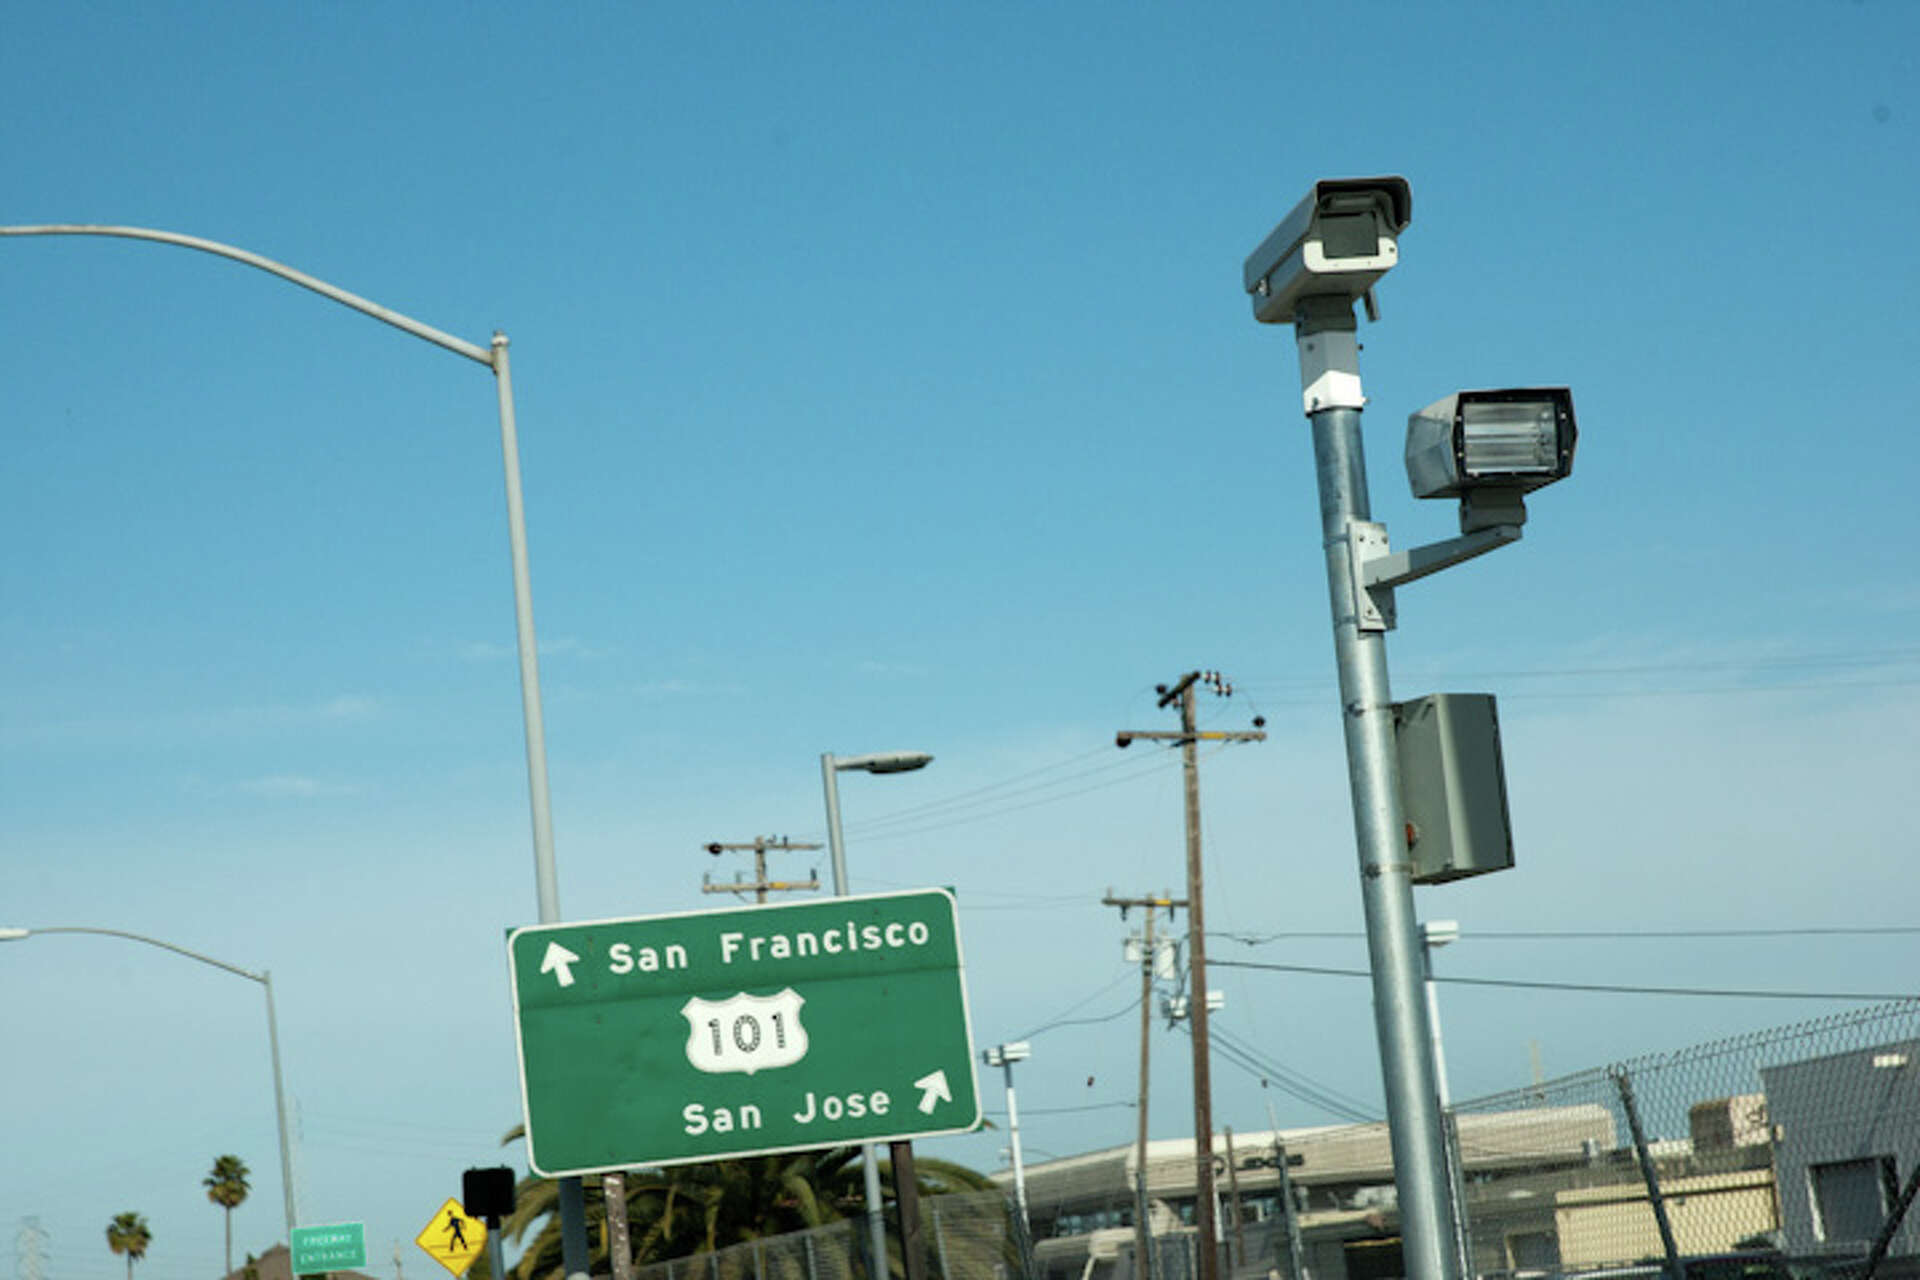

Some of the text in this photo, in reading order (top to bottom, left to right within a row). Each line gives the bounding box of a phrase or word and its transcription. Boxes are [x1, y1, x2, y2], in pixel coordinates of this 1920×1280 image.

[609, 921, 929, 974] San Francisco
[708, 1013, 786, 1056] 101
[683, 1091, 890, 1135] San Jose
